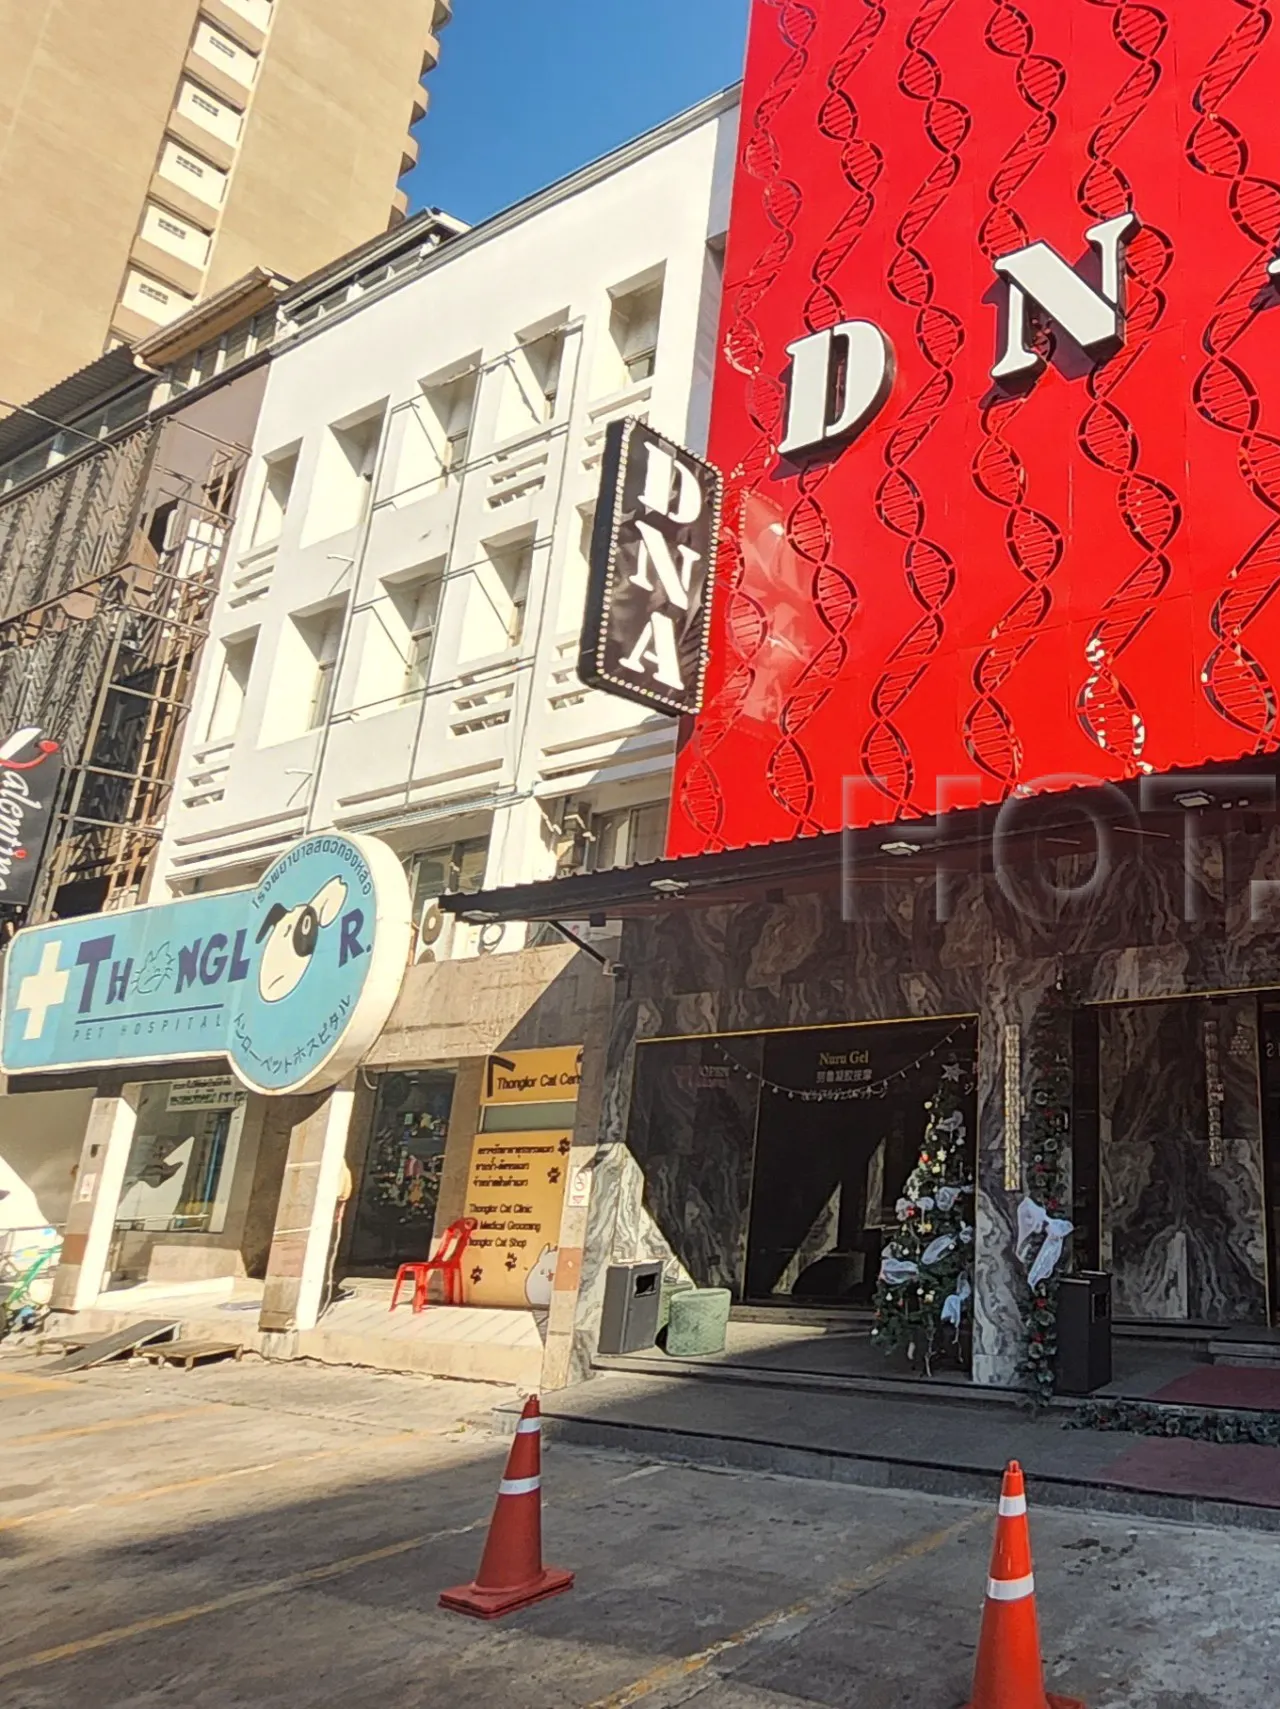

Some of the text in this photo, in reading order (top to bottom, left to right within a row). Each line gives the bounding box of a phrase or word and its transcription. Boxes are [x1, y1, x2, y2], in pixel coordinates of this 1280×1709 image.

[619, 441, 701, 690] DNA
[73, 1014, 221, 1042] PET HOSPITAL
[849, 1050, 869, 1064] Gel
[540, 1074, 557, 1087] Cat
